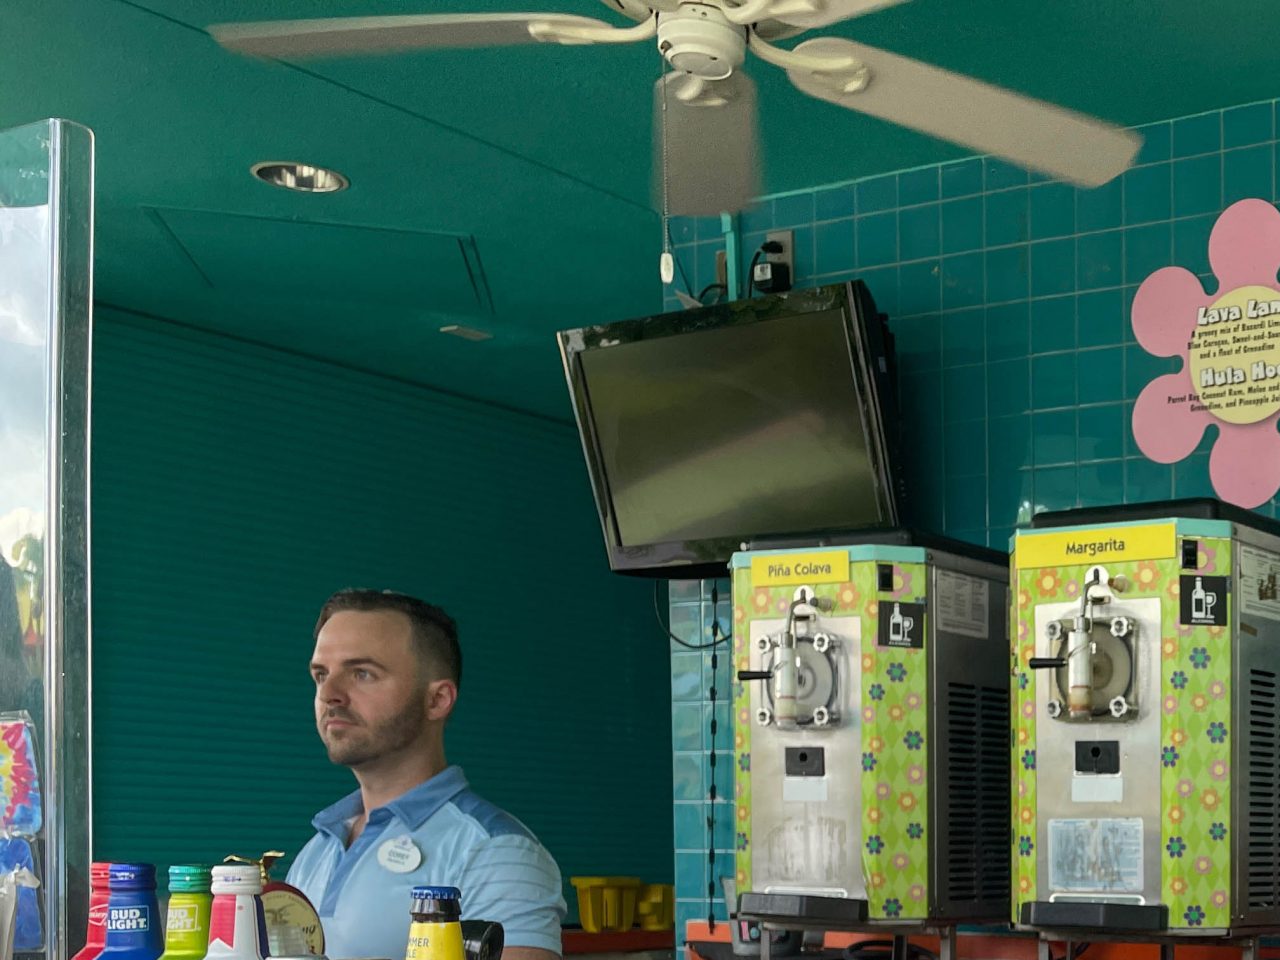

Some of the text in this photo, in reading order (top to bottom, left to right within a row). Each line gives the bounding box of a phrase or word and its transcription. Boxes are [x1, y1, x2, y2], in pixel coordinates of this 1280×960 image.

[1197, 306, 1242, 326] Lava
[1201, 367, 1245, 388] Hula
[1065, 537, 1126, 555] Margarita
[768, 562, 831, 577] Piña Colava
[111, 908, 140, 920] BUD
